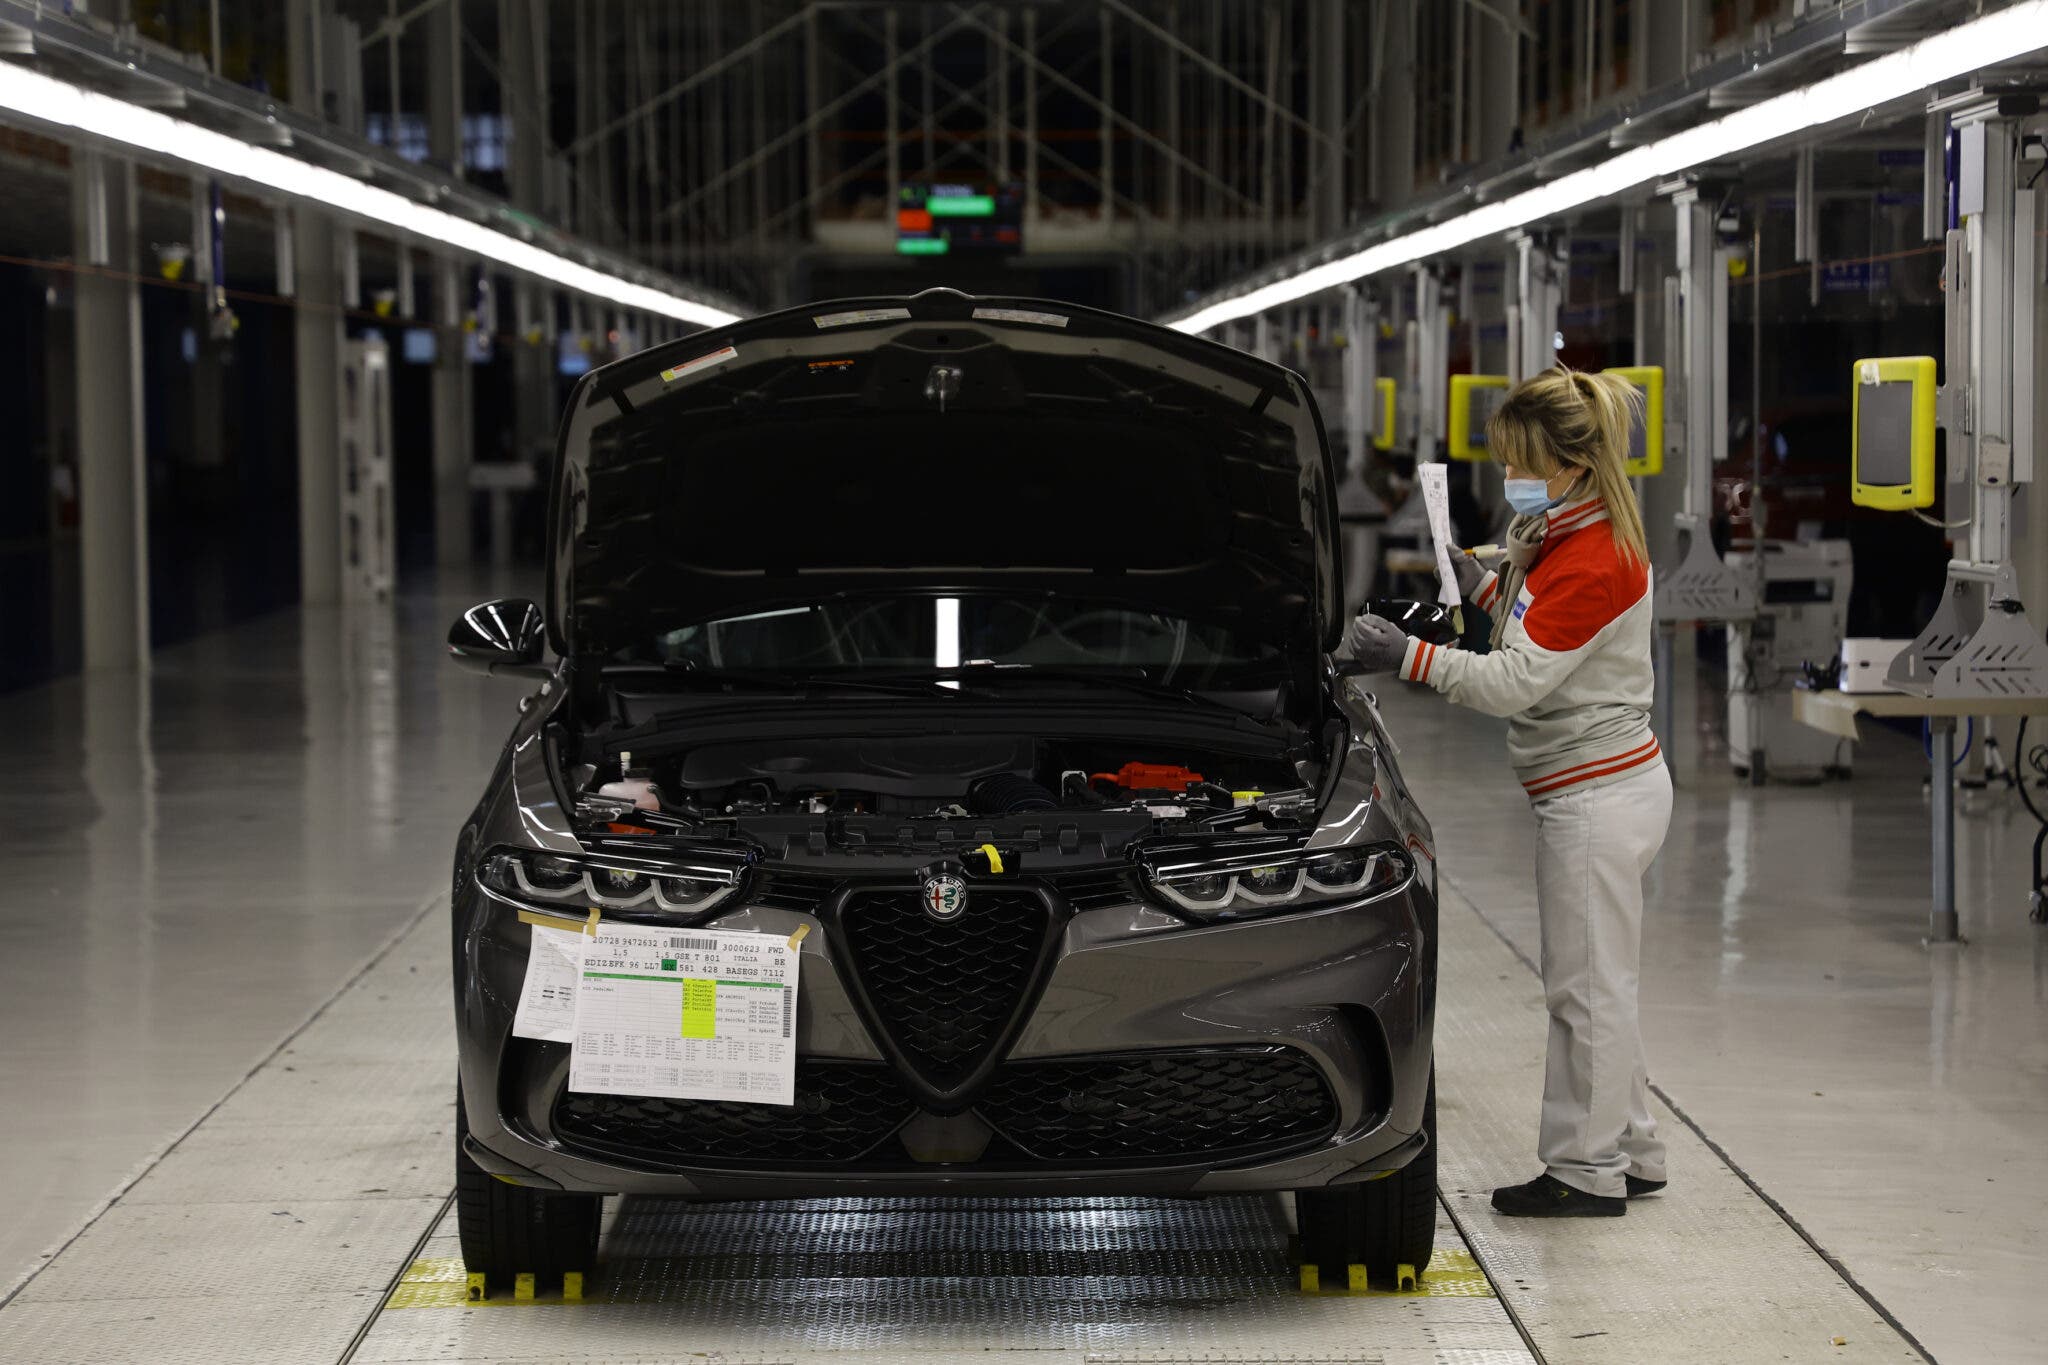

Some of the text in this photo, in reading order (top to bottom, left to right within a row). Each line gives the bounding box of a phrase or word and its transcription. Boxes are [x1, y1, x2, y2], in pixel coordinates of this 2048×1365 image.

[592, 936, 620, 945] 20728
[622, 938, 658, 947] 9472632
[722, 943, 760, 953] 3000623
[767, 946, 784, 954] FWD
[674, 952, 690, 960] GSE
[704, 954, 720, 962] 801
[774, 958, 786, 966] BE
[629, 961, 639, 969] 96
[679, 964, 694, 972] 581
[702, 965, 719, 974] 428
[726, 967, 759, 976] BASEGS
[763, 968, 785, 977] 7112
